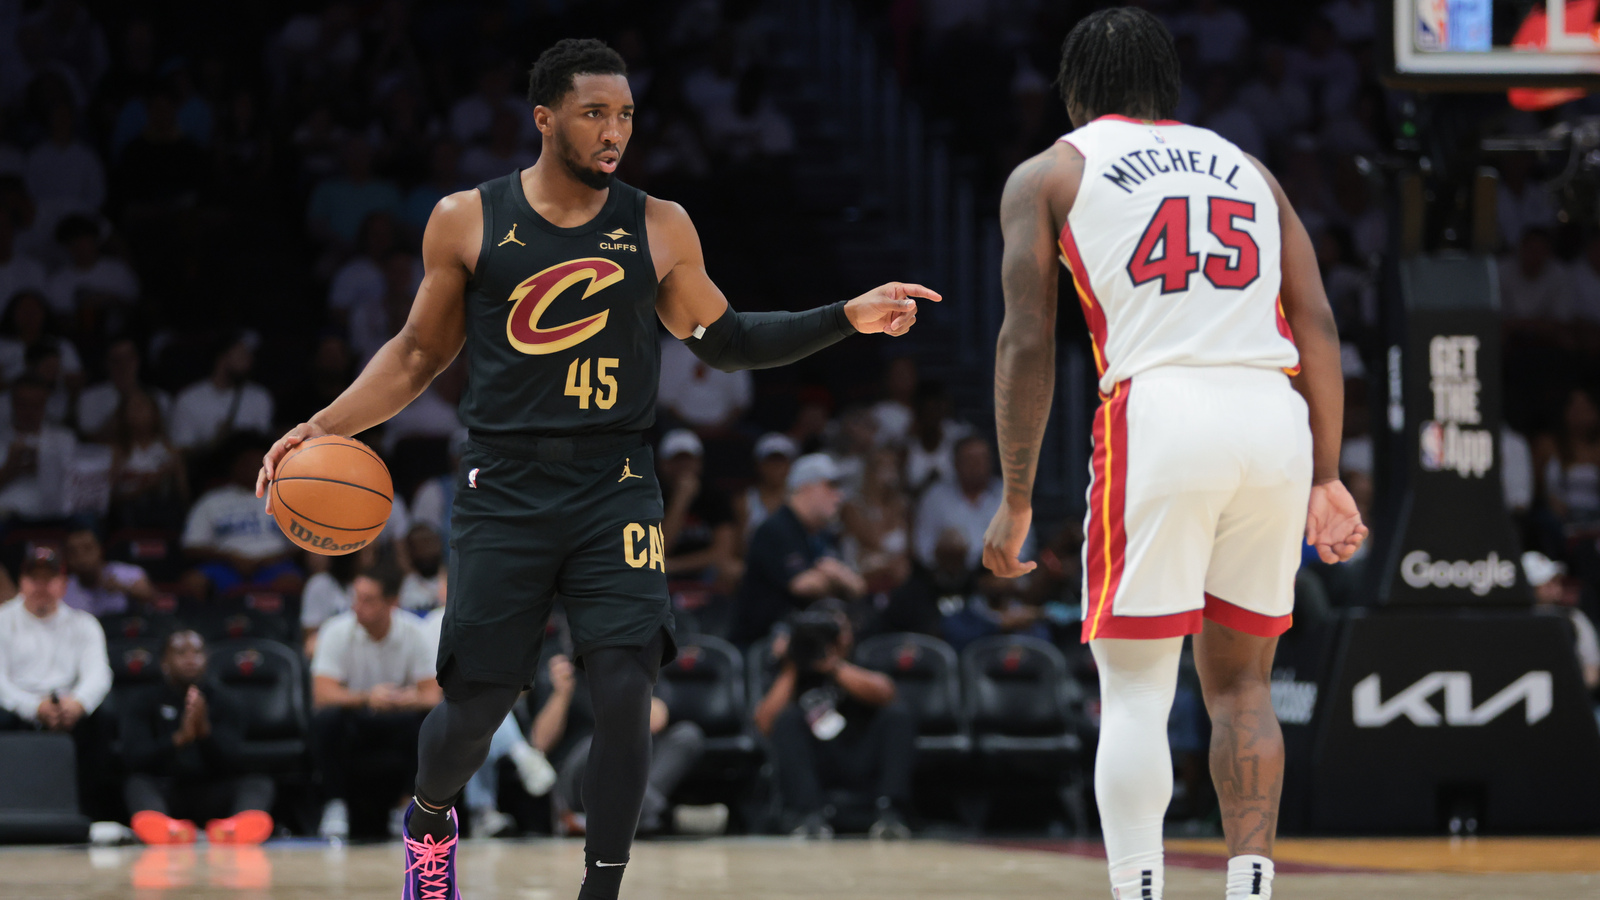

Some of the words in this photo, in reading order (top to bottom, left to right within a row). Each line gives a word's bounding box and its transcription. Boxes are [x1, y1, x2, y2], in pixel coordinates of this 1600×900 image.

[1103, 148, 1240, 194] MITCHELL
[599, 241, 637, 252] CLIFFS
[1126, 195, 1260, 295] 45
[506, 257, 625, 355] C
[1430, 336, 1479, 377] GET
[563, 357, 620, 409] 45
[1431, 378, 1479, 423] THE
[289, 518, 367, 551] Wilson
[623, 521, 665, 574] CA
[1401, 550, 1516, 596] Google
[1352, 670, 1553, 728] KIA
